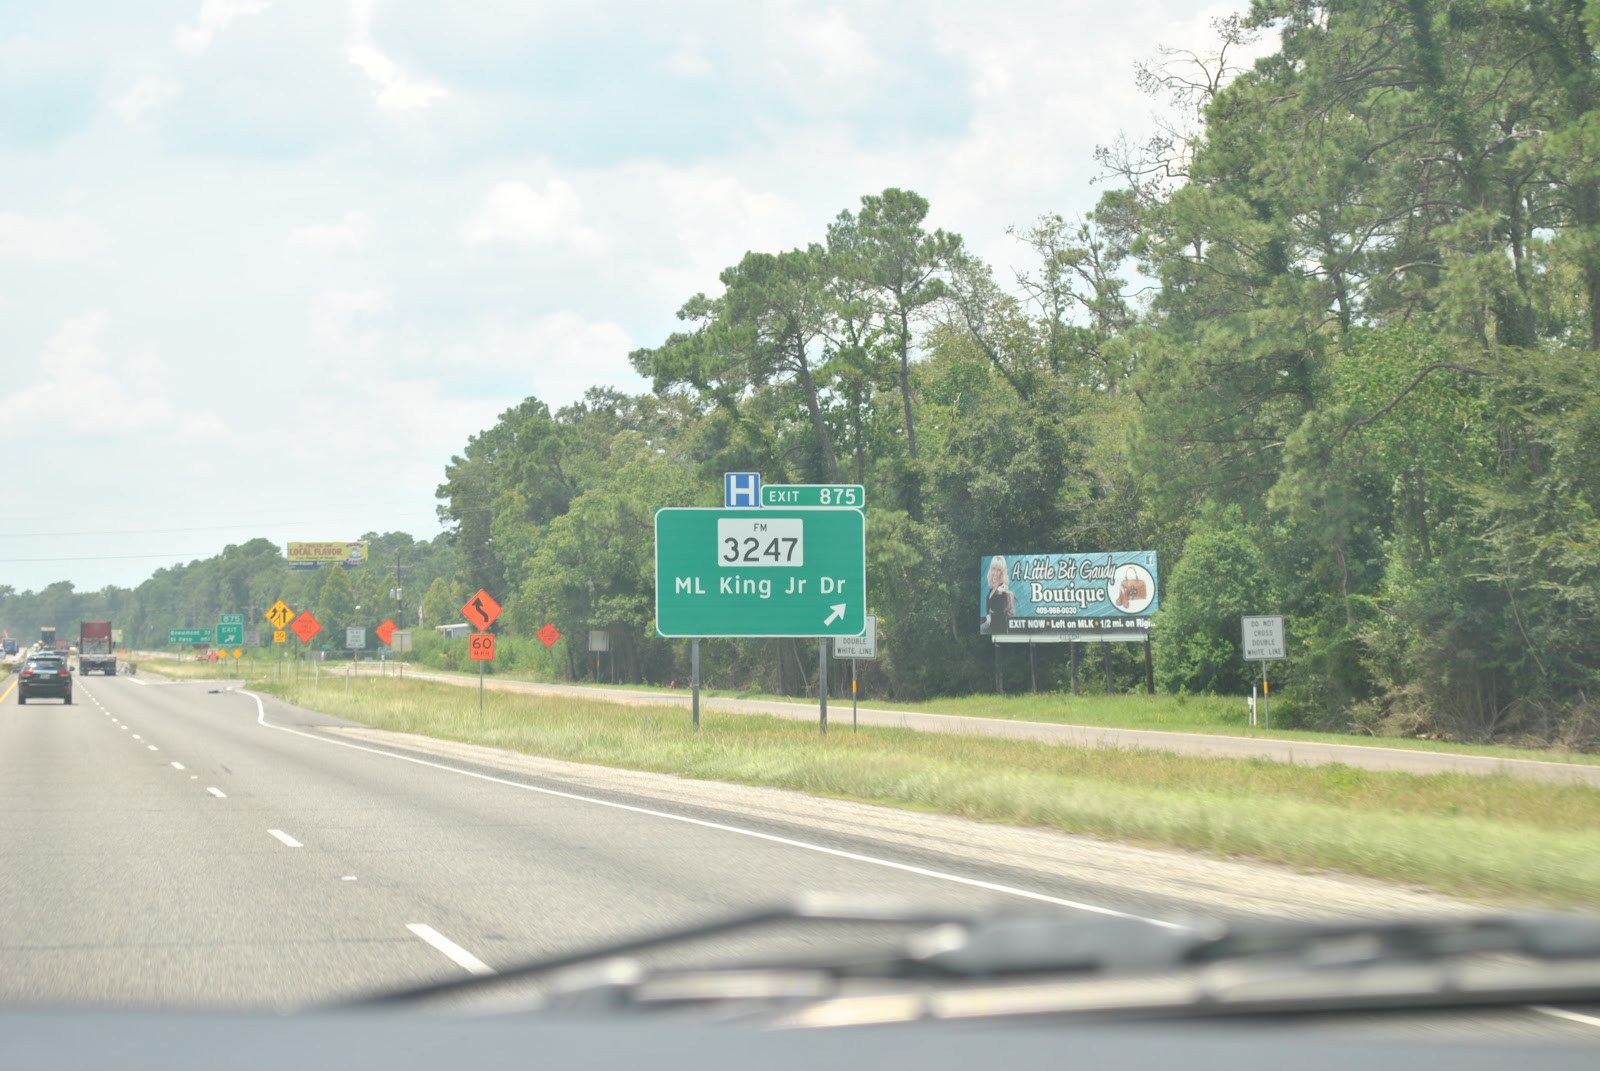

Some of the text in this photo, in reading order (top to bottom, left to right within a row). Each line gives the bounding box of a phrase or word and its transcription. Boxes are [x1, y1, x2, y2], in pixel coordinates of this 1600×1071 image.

[730, 475, 755, 506] H
[769, 488, 856, 505] EXIT 875
[753, 523, 768, 532] FM
[723, 537, 798, 562] 3247
[1012, 555, 1117, 585] A Little Bit Gaudy
[675, 576, 846, 598] ML King Jr Dr
[1031, 582, 1105, 608] Boutique
[1009, 620, 1026, 628] EXIT
[1028, 620, 1045, 628] NOW
[1051, 619, 1065, 628] Left
[1078, 618, 1094, 628] MLK
[1100, 618, 1112, 629] 1/2
[1113, 618, 1124, 628] mi.
[472, 638, 492, 649] 60
